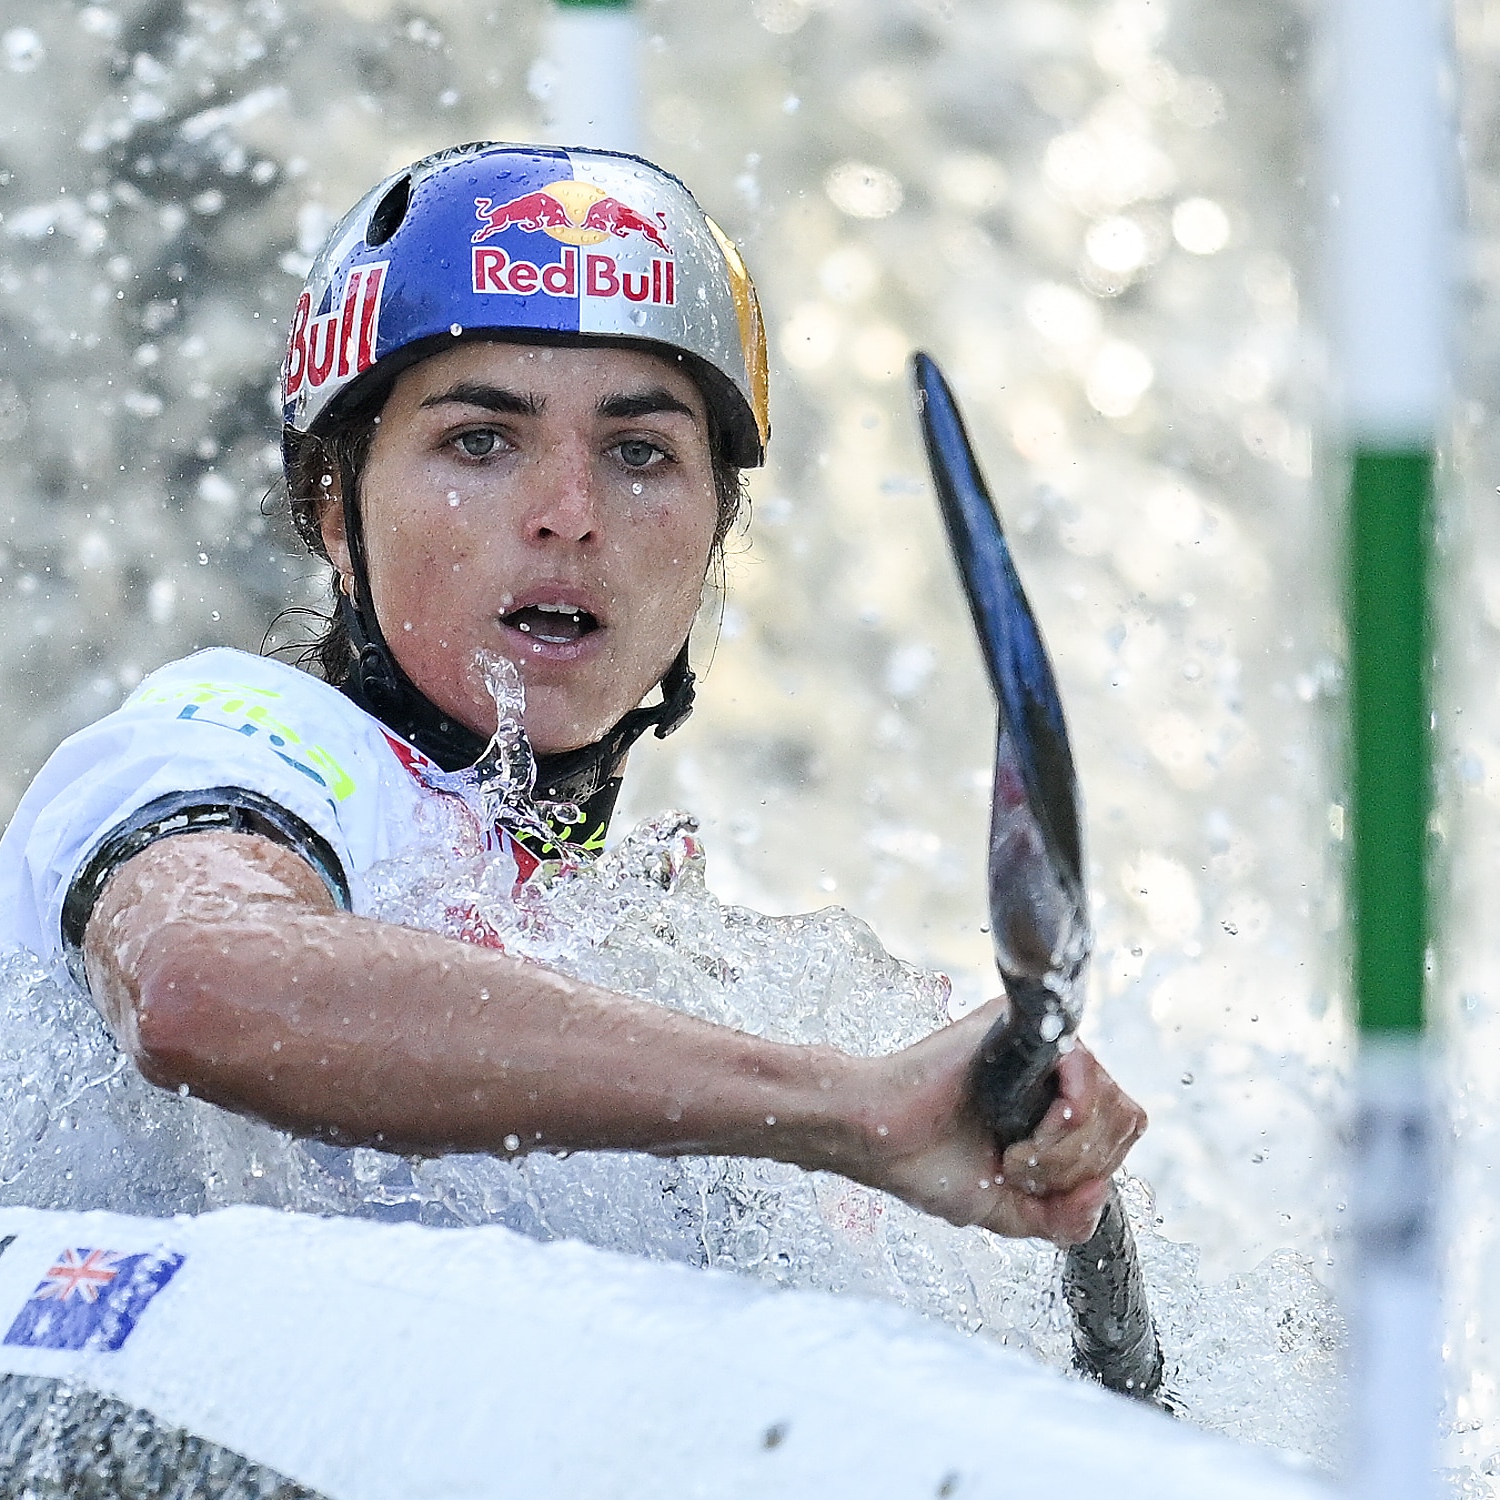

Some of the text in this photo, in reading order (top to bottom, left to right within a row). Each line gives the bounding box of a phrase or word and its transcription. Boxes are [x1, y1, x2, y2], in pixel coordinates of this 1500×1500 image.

[475, 249, 675, 305] Red Bull
[285, 268, 383, 396] Bull
